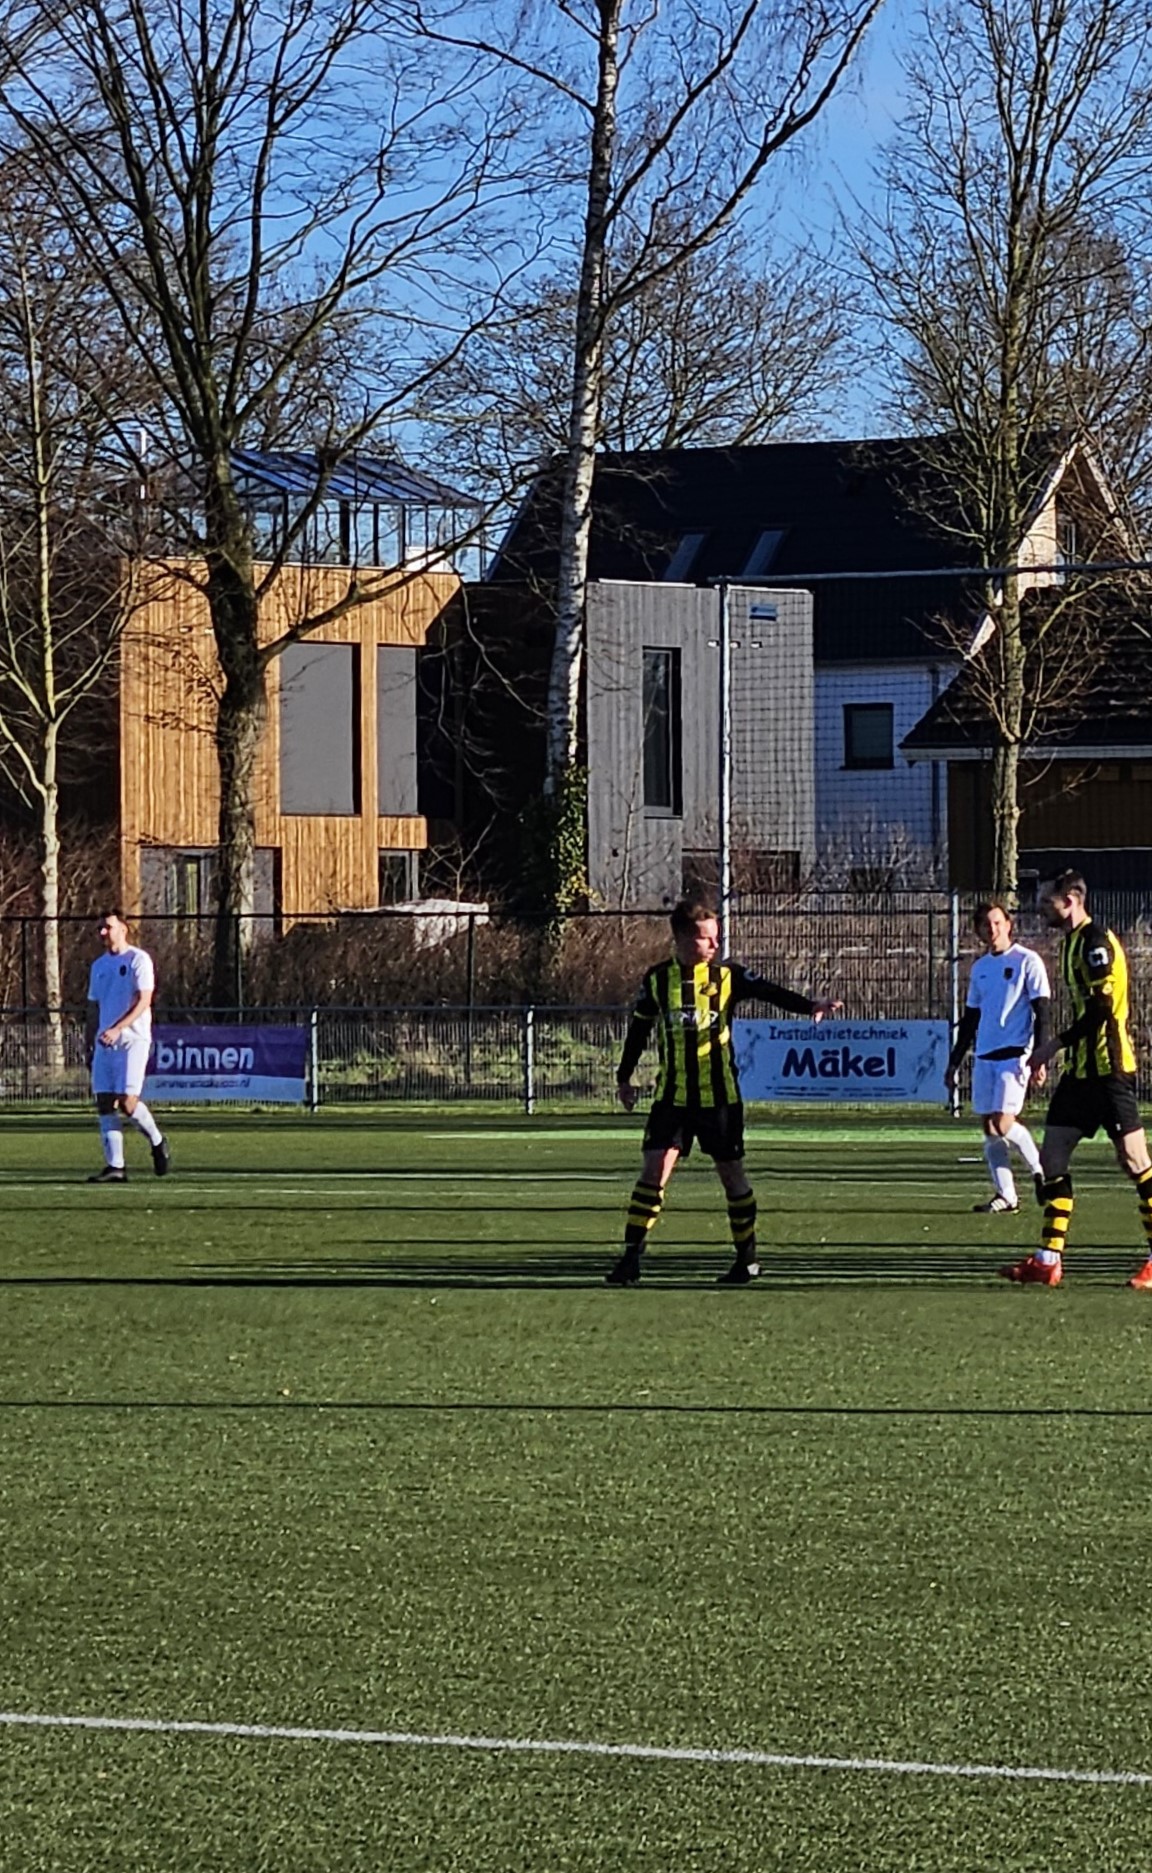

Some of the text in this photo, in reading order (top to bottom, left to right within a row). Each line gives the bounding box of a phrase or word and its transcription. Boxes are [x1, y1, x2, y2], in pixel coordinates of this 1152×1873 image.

[768, 1026, 909, 1041] Installatietechniek
[156, 1038, 255, 1070] binnen
[781, 1046, 896, 1079] Mäkel
